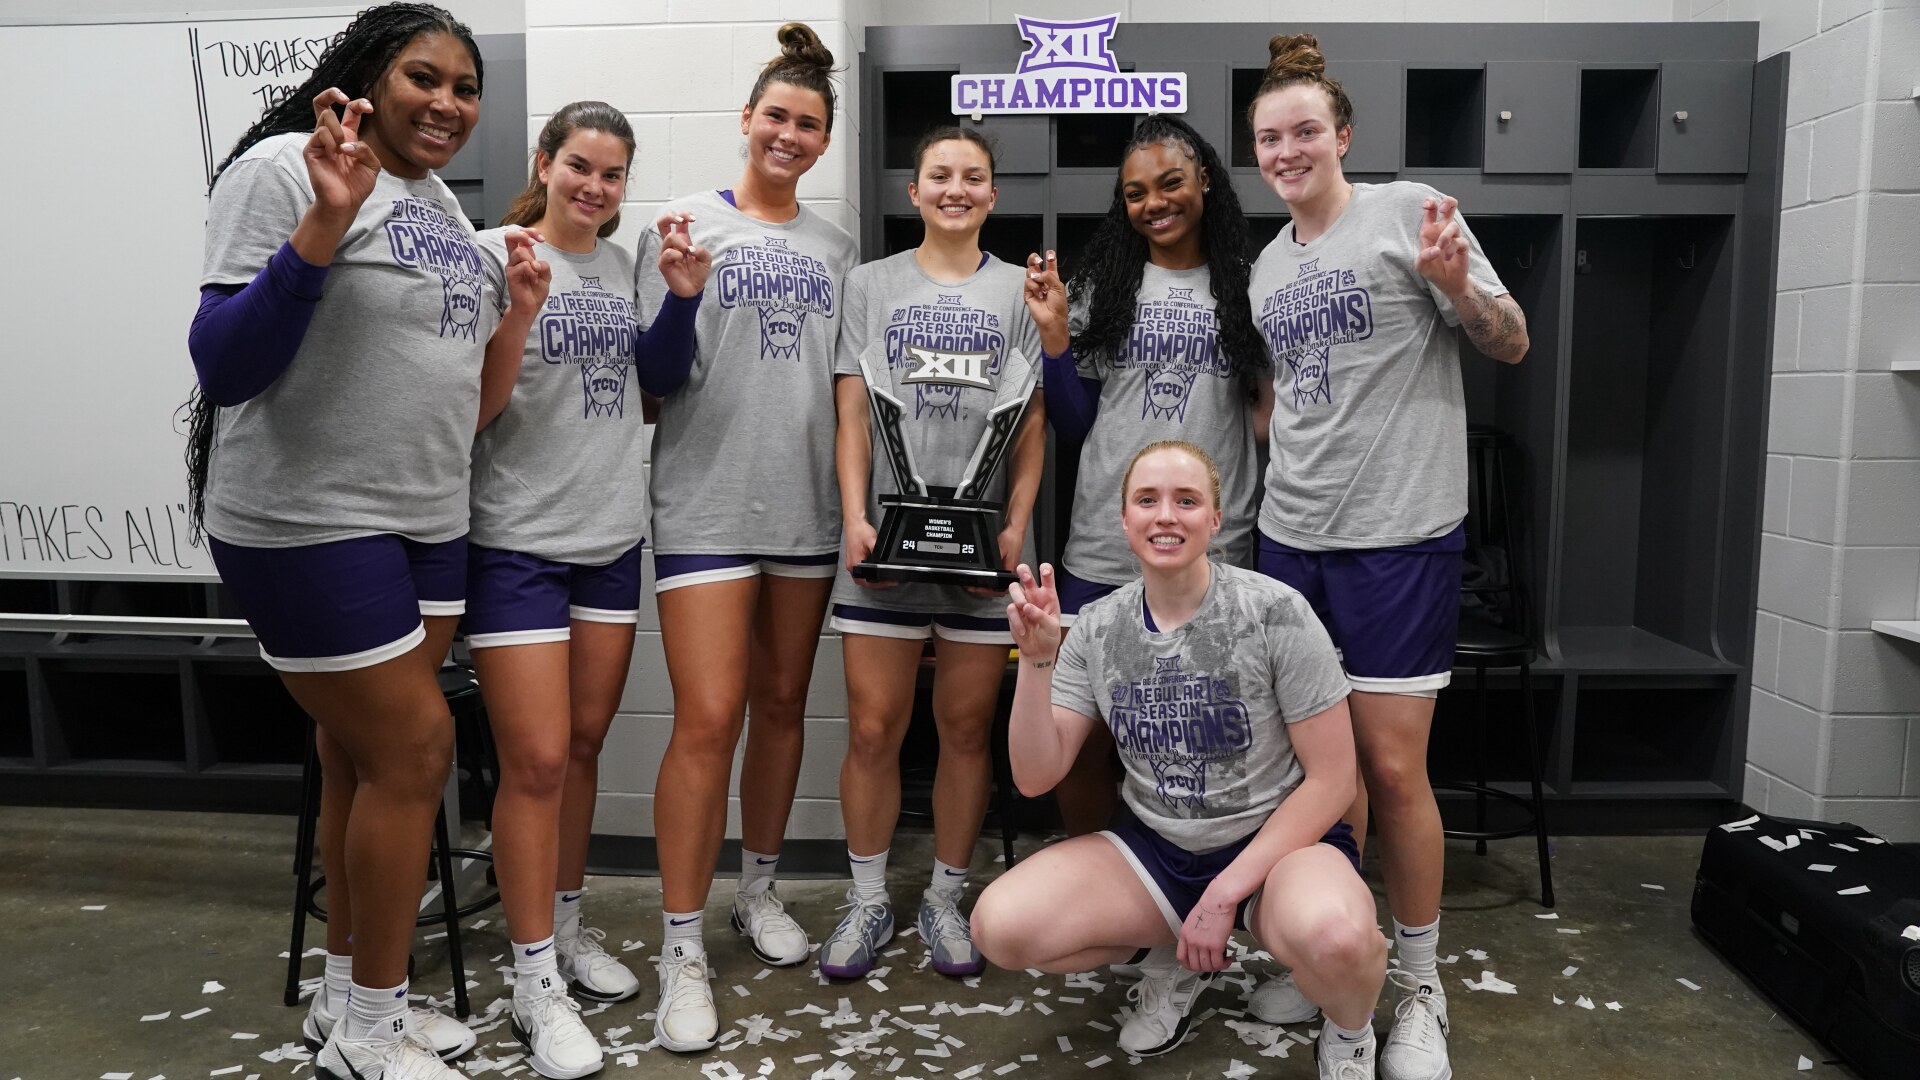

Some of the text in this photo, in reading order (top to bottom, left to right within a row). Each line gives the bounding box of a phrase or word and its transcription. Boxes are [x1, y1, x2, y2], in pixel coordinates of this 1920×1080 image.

[1024, 21, 1111, 69] XII
[957, 77, 1181, 109] CHAMPIONS
[725, 249, 739, 261] 20
[747, 250, 809, 269] REGULAR
[753, 261, 809, 278] SEASON
[722, 267, 832, 312] CHAMPIONS
[1276, 276, 1333, 307] REGULAR
[452, 293, 476, 313] TCU
[547, 296, 560, 310] 20
[568, 298, 626, 314] REGULAR
[734, 295, 779, 308] Women's
[1170, 301, 1204, 309] CONFERENCE
[1279, 291, 1329, 319] SEASON
[574, 311, 627, 326] SEASON
[892, 308, 906, 322] 20
[912, 310, 979, 324] REGULAR
[1143, 307, 1211, 324] REGULAR
[1263, 294, 1367, 353] CHAMPIONS
[768, 321, 797, 337] TCU
[915, 322, 973, 335] SEASON
[1145, 319, 1207, 336] SEASON
[545, 318, 638, 358] CHAMPION
[1305, 329, 1358, 354] Basketball
[560, 351, 601, 365] Women's
[907, 346, 992, 386] XII
[1126, 356, 1221, 377] Women's Basketball
[1300, 364, 1321, 383] TCU
[591, 378, 619, 393] TCU
[1153, 382, 1184, 399] TCU
[0, 502, 113, 562] TAKES
[924, 525, 955, 533] BASKETBALL
[902, 540, 916, 550] 24
[961, 544, 975, 554] 25
[1142, 678, 1151, 686] BIG
[1158, 674, 1194, 685] CONFERENCE
[1112, 684, 1129, 702] 20
[1135, 683, 1204, 704] REGULAR
[1138, 701, 1201, 719] SEASON
[1113, 706, 1245, 753] CHAMPIONS
[1124, 744, 1170, 761] Women's
[1165, 775, 1196, 791] TCU
